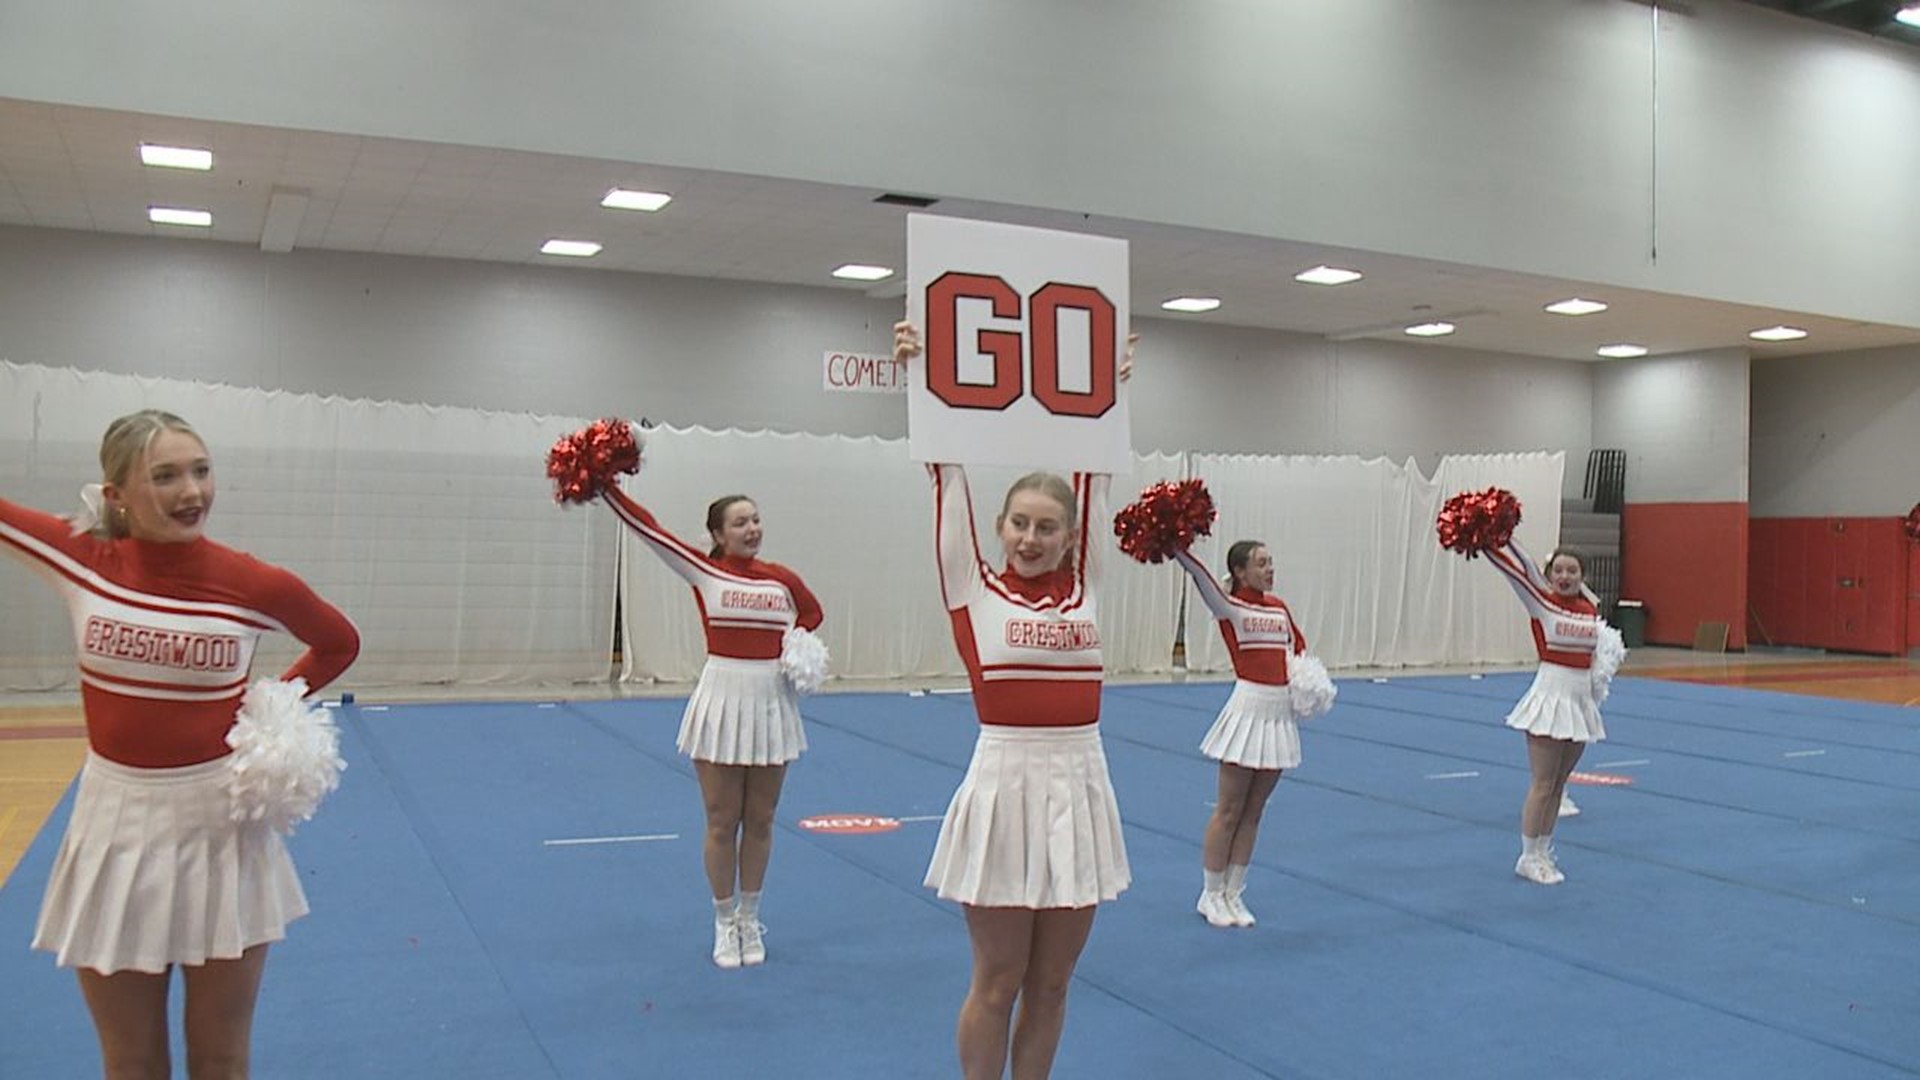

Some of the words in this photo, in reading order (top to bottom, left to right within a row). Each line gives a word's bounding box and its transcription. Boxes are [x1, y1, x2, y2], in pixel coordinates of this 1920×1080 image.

[828, 354, 908, 387] COMET
[925, 271, 1115, 419] GO
[85, 615, 240, 672] CRESTWOOD
